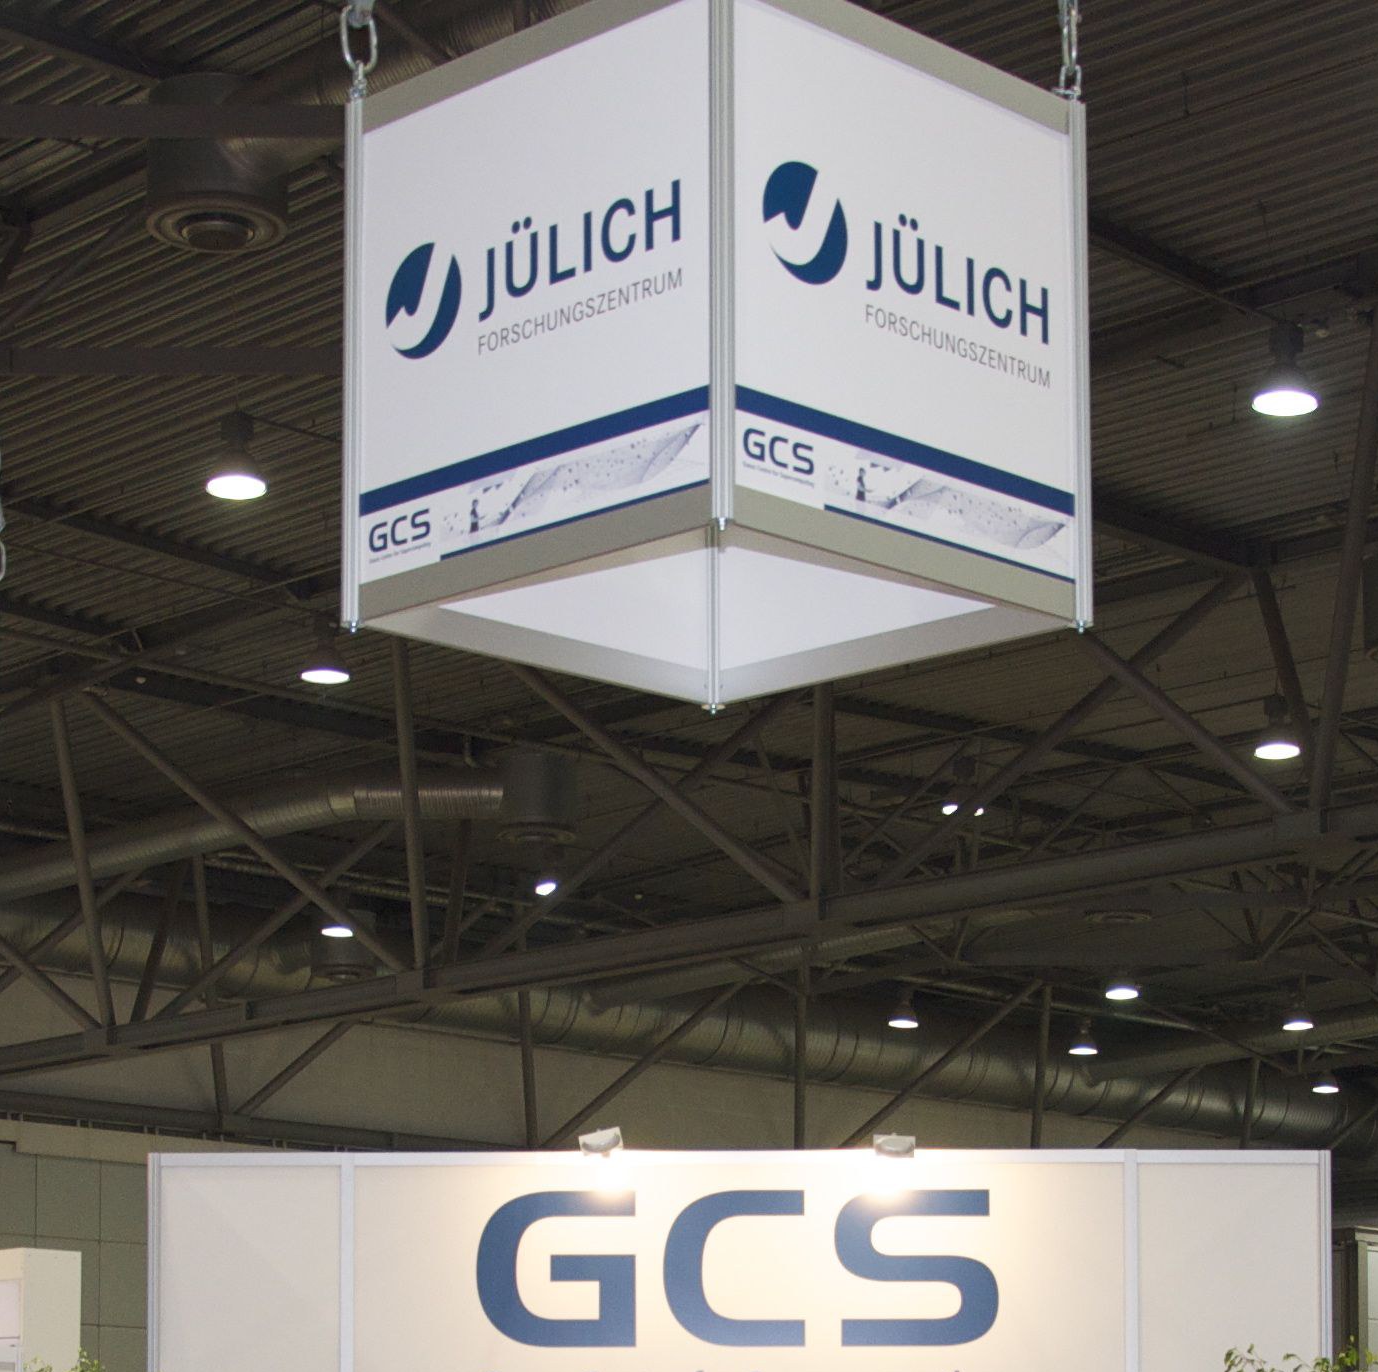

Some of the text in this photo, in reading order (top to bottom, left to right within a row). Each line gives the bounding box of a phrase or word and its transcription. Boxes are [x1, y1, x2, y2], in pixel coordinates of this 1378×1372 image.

[477, 178, 682, 322] JÜLICH
[865, 213, 1051, 346] JÜLICH
[477, 267, 683, 356] FORSCHUNGSZENTRUM
[864, 304, 1052, 389] FORSCHUNGSZENTRUM
[742, 427, 815, 476] GCS
[368, 508, 431, 553] GCS
[475, 1188, 1000, 1349] GCS
